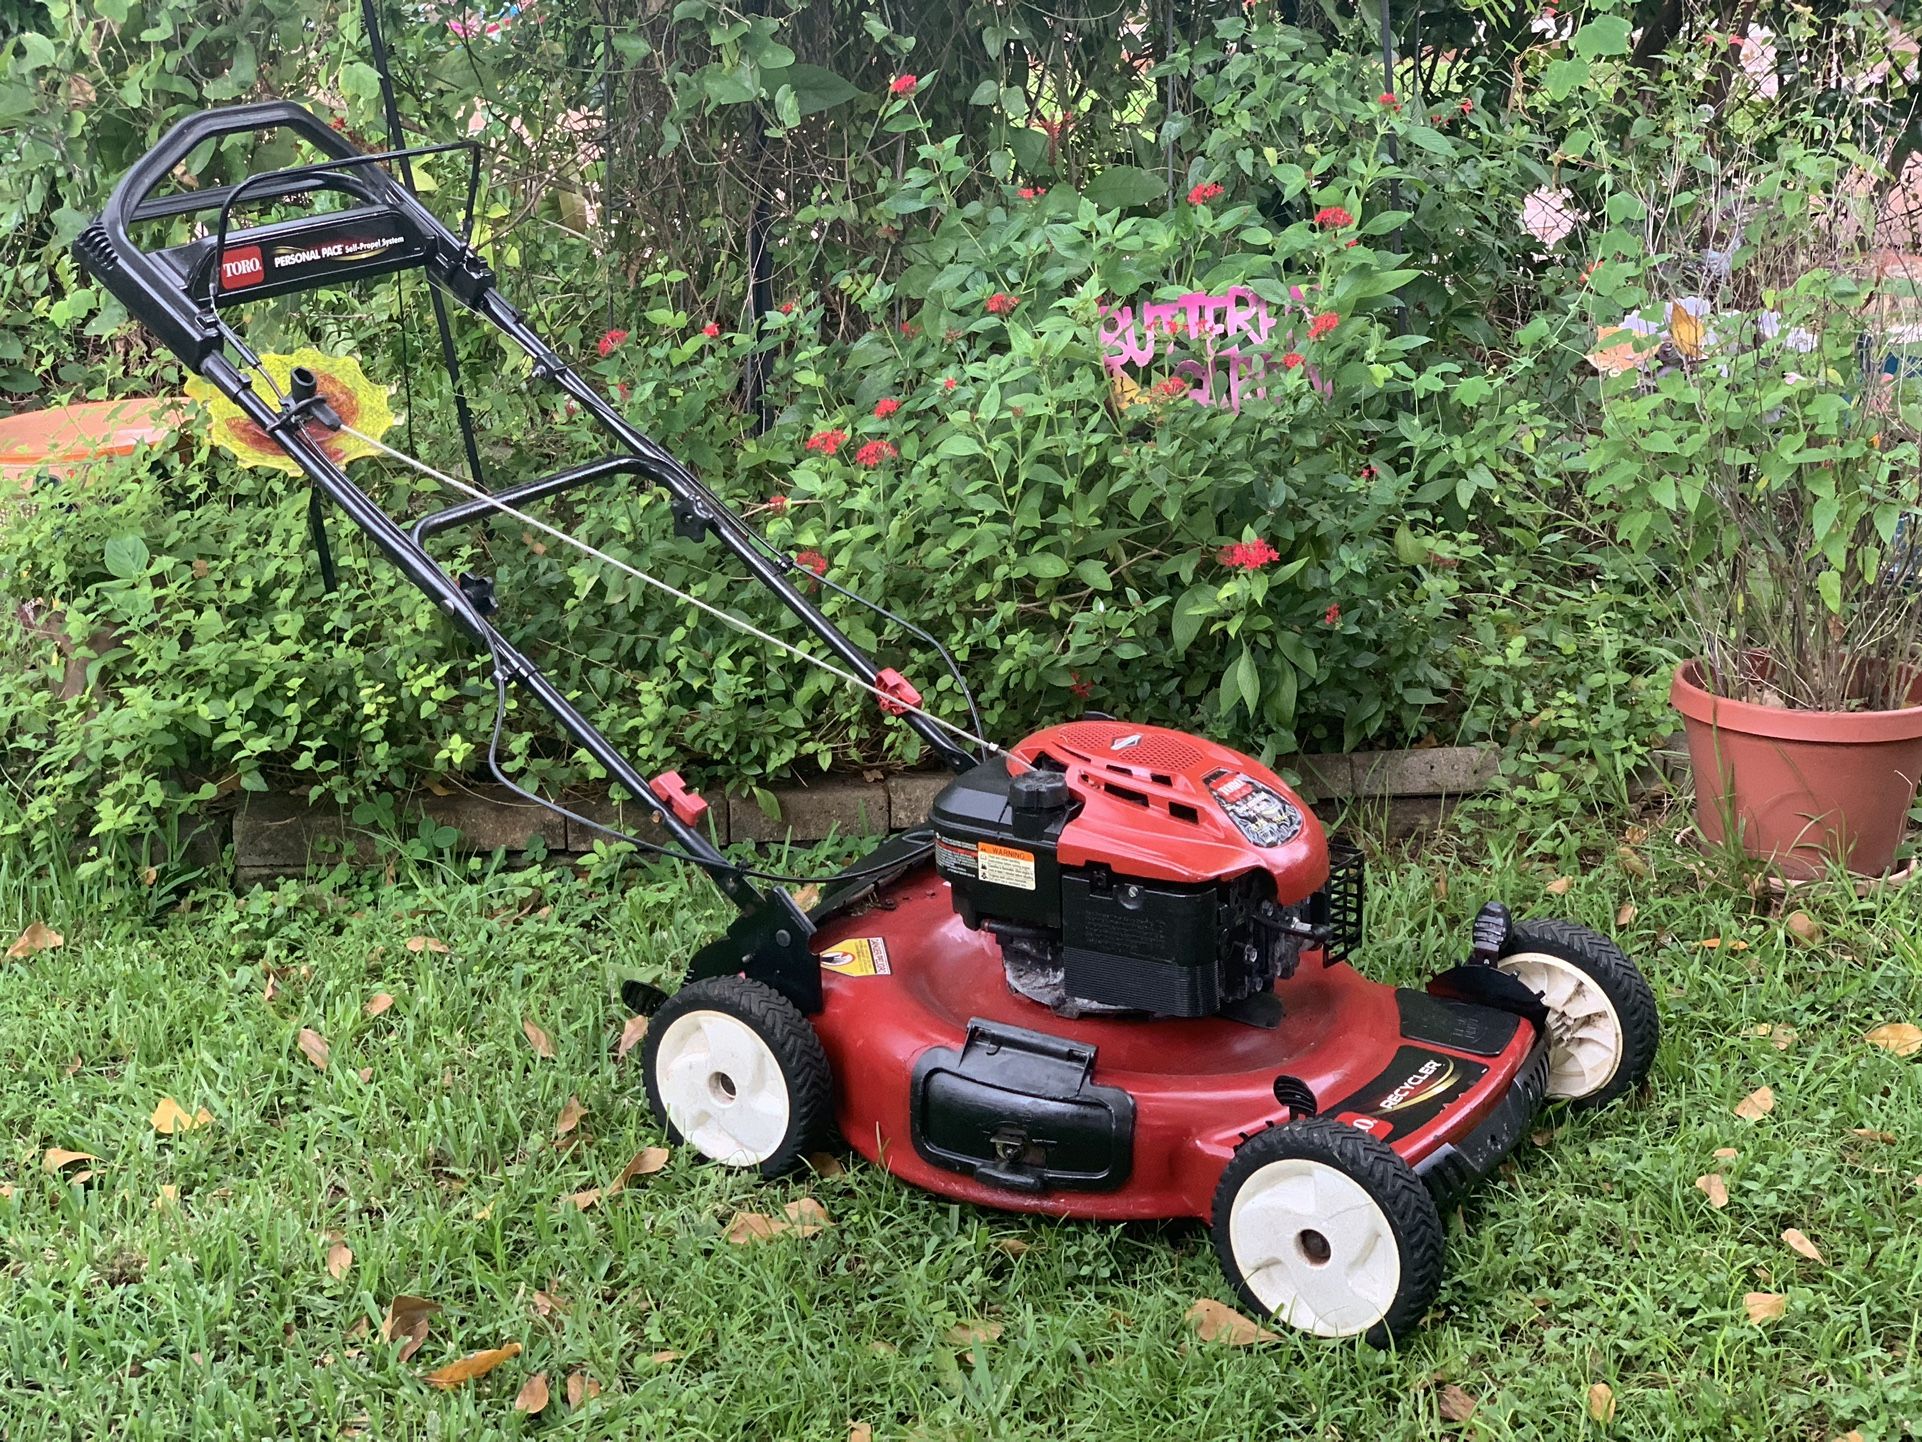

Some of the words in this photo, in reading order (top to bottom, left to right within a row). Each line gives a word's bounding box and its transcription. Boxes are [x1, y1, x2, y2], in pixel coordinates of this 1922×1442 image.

[274, 249, 321, 267] PERSONAL
[321, 245, 343, 259] PACE
[345, 238, 381, 254] Self-Propel
[382, 235, 405, 248] System
[222, 257, 260, 278] TORO
[992, 847, 1025, 860] WARNING
[1379, 1059, 1442, 1110] RECYCLER
